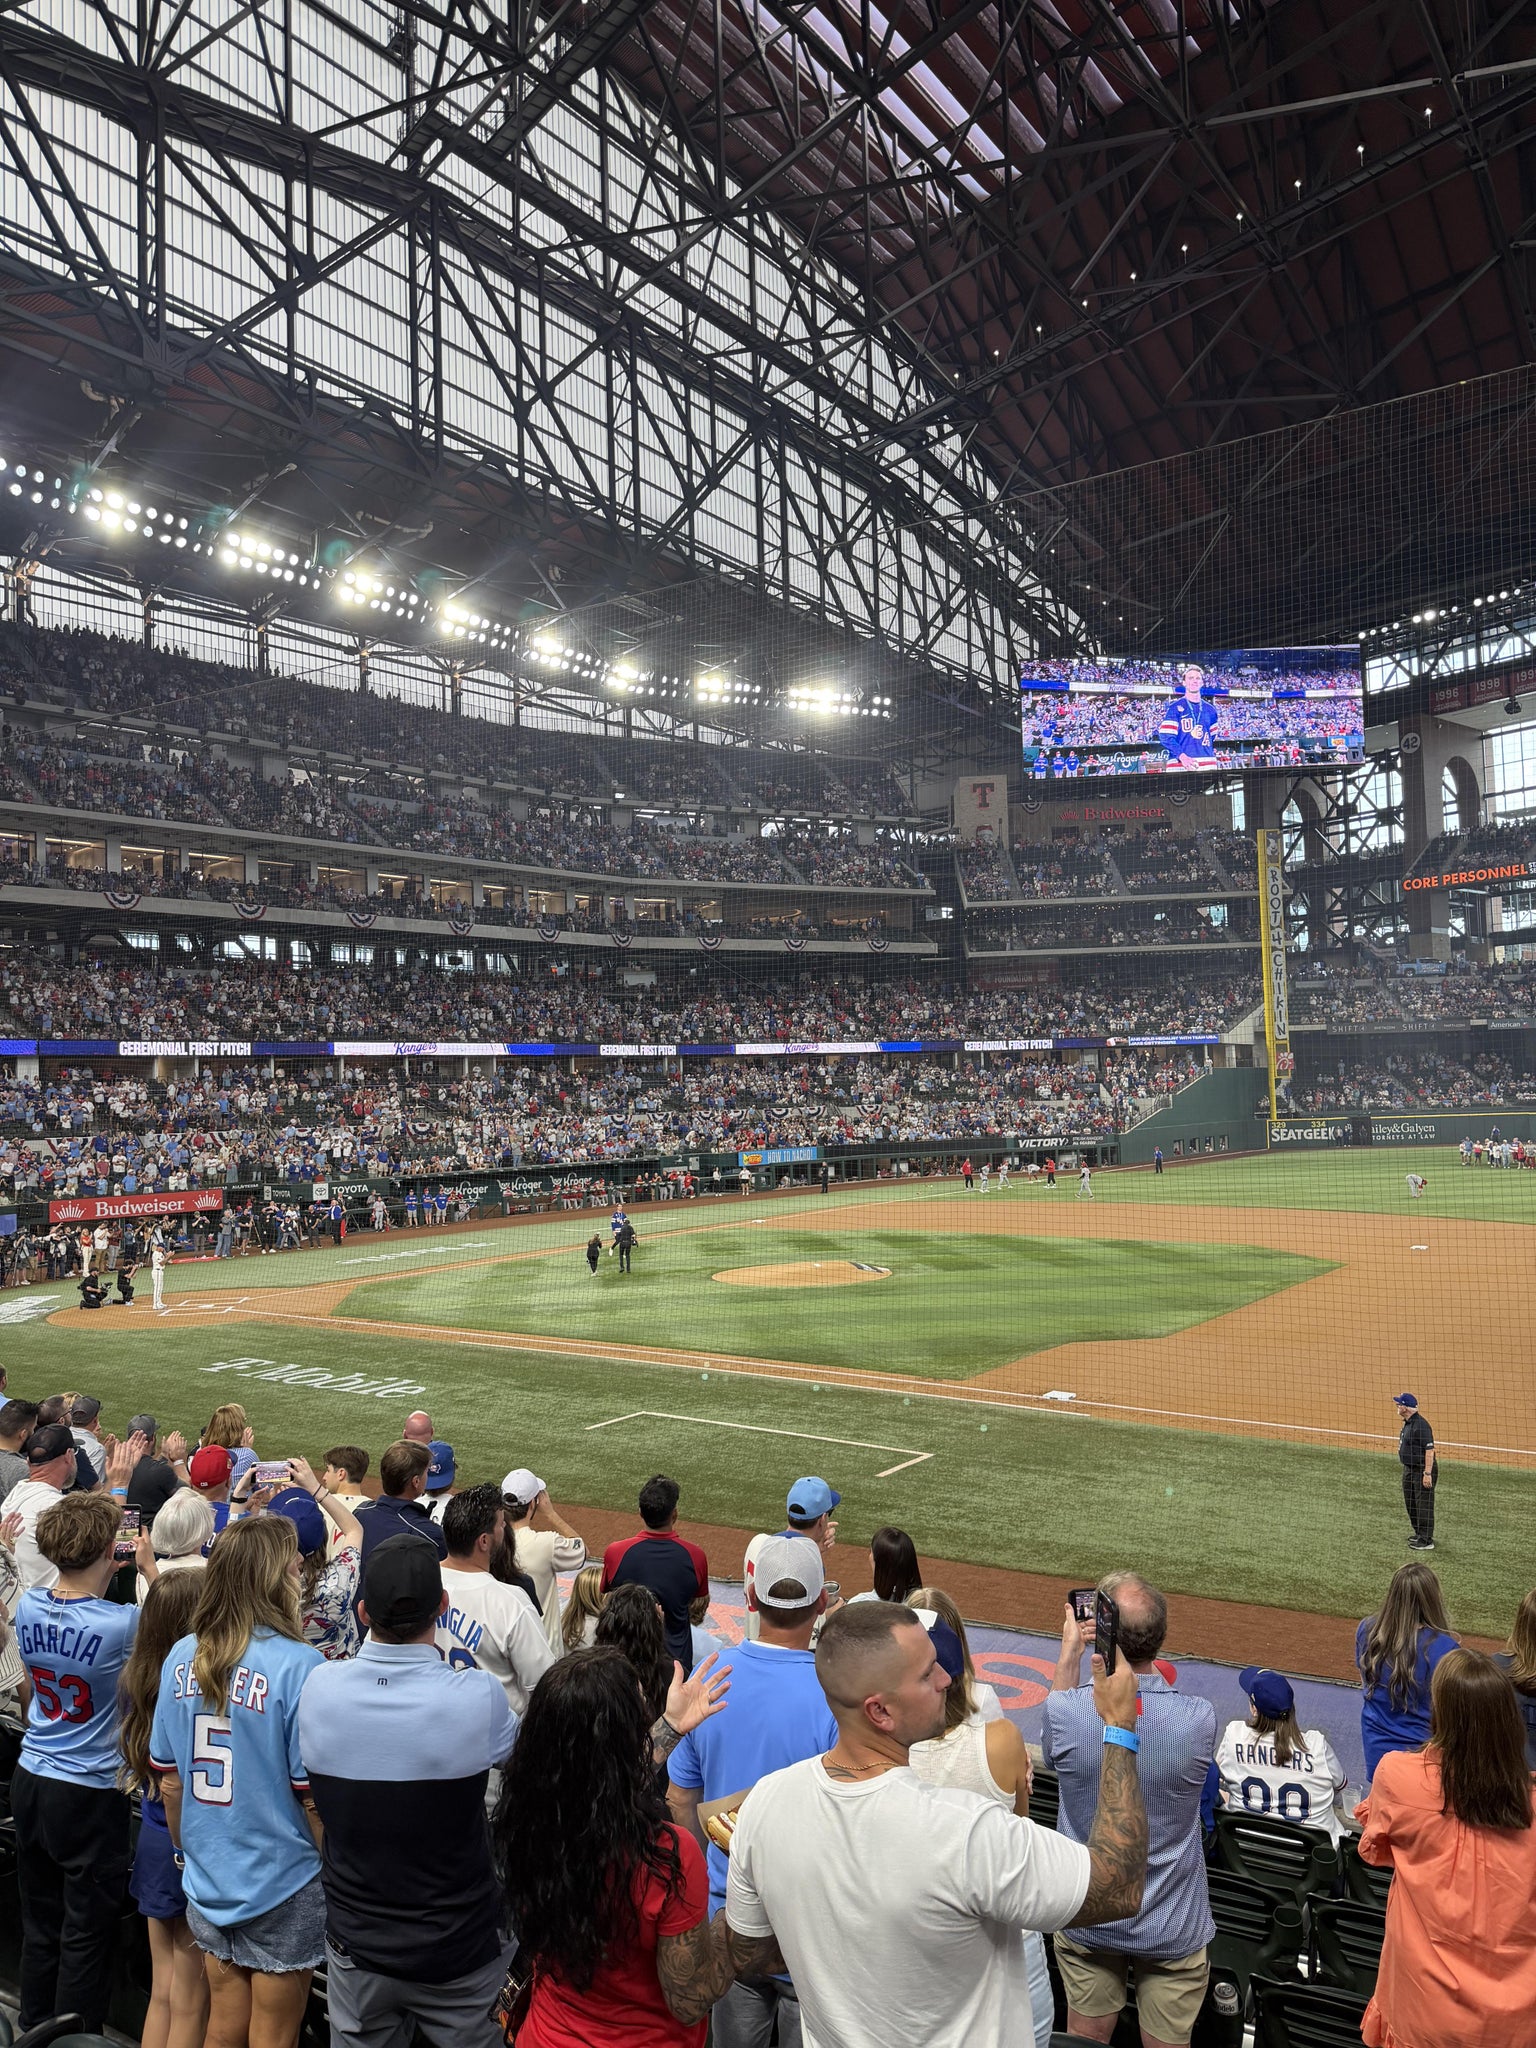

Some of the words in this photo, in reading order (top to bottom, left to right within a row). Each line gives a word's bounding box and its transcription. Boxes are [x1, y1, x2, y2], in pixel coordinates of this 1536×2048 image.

[1517, 669, 1536, 683] 199
[1477, 677, 1501, 692] 1998
[1435, 687, 1460, 701] 1996
[1402, 736, 1418, 750] 42
[1084, 806, 1164, 821] Budweiser
[1402, 876, 1439, 891] CORE
[1442, 863, 1529, 886] PERSONNEL
[1271, 931, 1283, 945] 4
[1273, 953, 1287, 1037] CHIKIN
[1491, 1021, 1521, 1029] American
[119, 1041, 188, 1056] CEREMONIAL
[189, 1042, 219, 1056] FIRST
[220, 1042, 251, 1056] PITCH
[393, 1041, 438, 1056] Rangers
[600, 1044, 640, 1056] CEREMONIAL
[640, 1044, 658, 1056] FIRST
[658, 1044, 677, 1056] PITCH
[964, 1041, 1008, 1051] CEREMONIAL
[1008, 1040, 1029, 1050] FIRST
[1030, 1039, 1053, 1050] PITCH
[1271, 1121, 1287, 1129] 329
[1311, 1120, 1327, 1128] 334
[1371, 1122, 1435, 1136] ailey&Galyen
[1271, 1126, 1337, 1142] SEATGEEK
[1420, 1132, 1436, 1140] LAW
[1018, 1138, 1065, 1148] VICTORY
[767, 1151, 781, 1164] HOW
[783, 1150, 791, 1163] TO
[792, 1149, 814, 1162] NACHO!
[511, 1176, 543, 1195] Kroger
[563, 1172, 593, 1190] Kroger
[272, 1189, 291, 1198] TOYOTA
[332, 1184, 369, 1195] TOYOTA
[455, 1180, 489, 1200] Kroger
[95, 1198, 185, 1217] Budweiser
[21, 1623, 104, 1667] GARCÍA
[30, 1665, 95, 1724] 53
[173, 1660, 269, 1714] SEER
[189, 1713, 234, 1807] 5
[1241, 1775, 1312, 1824] 00
